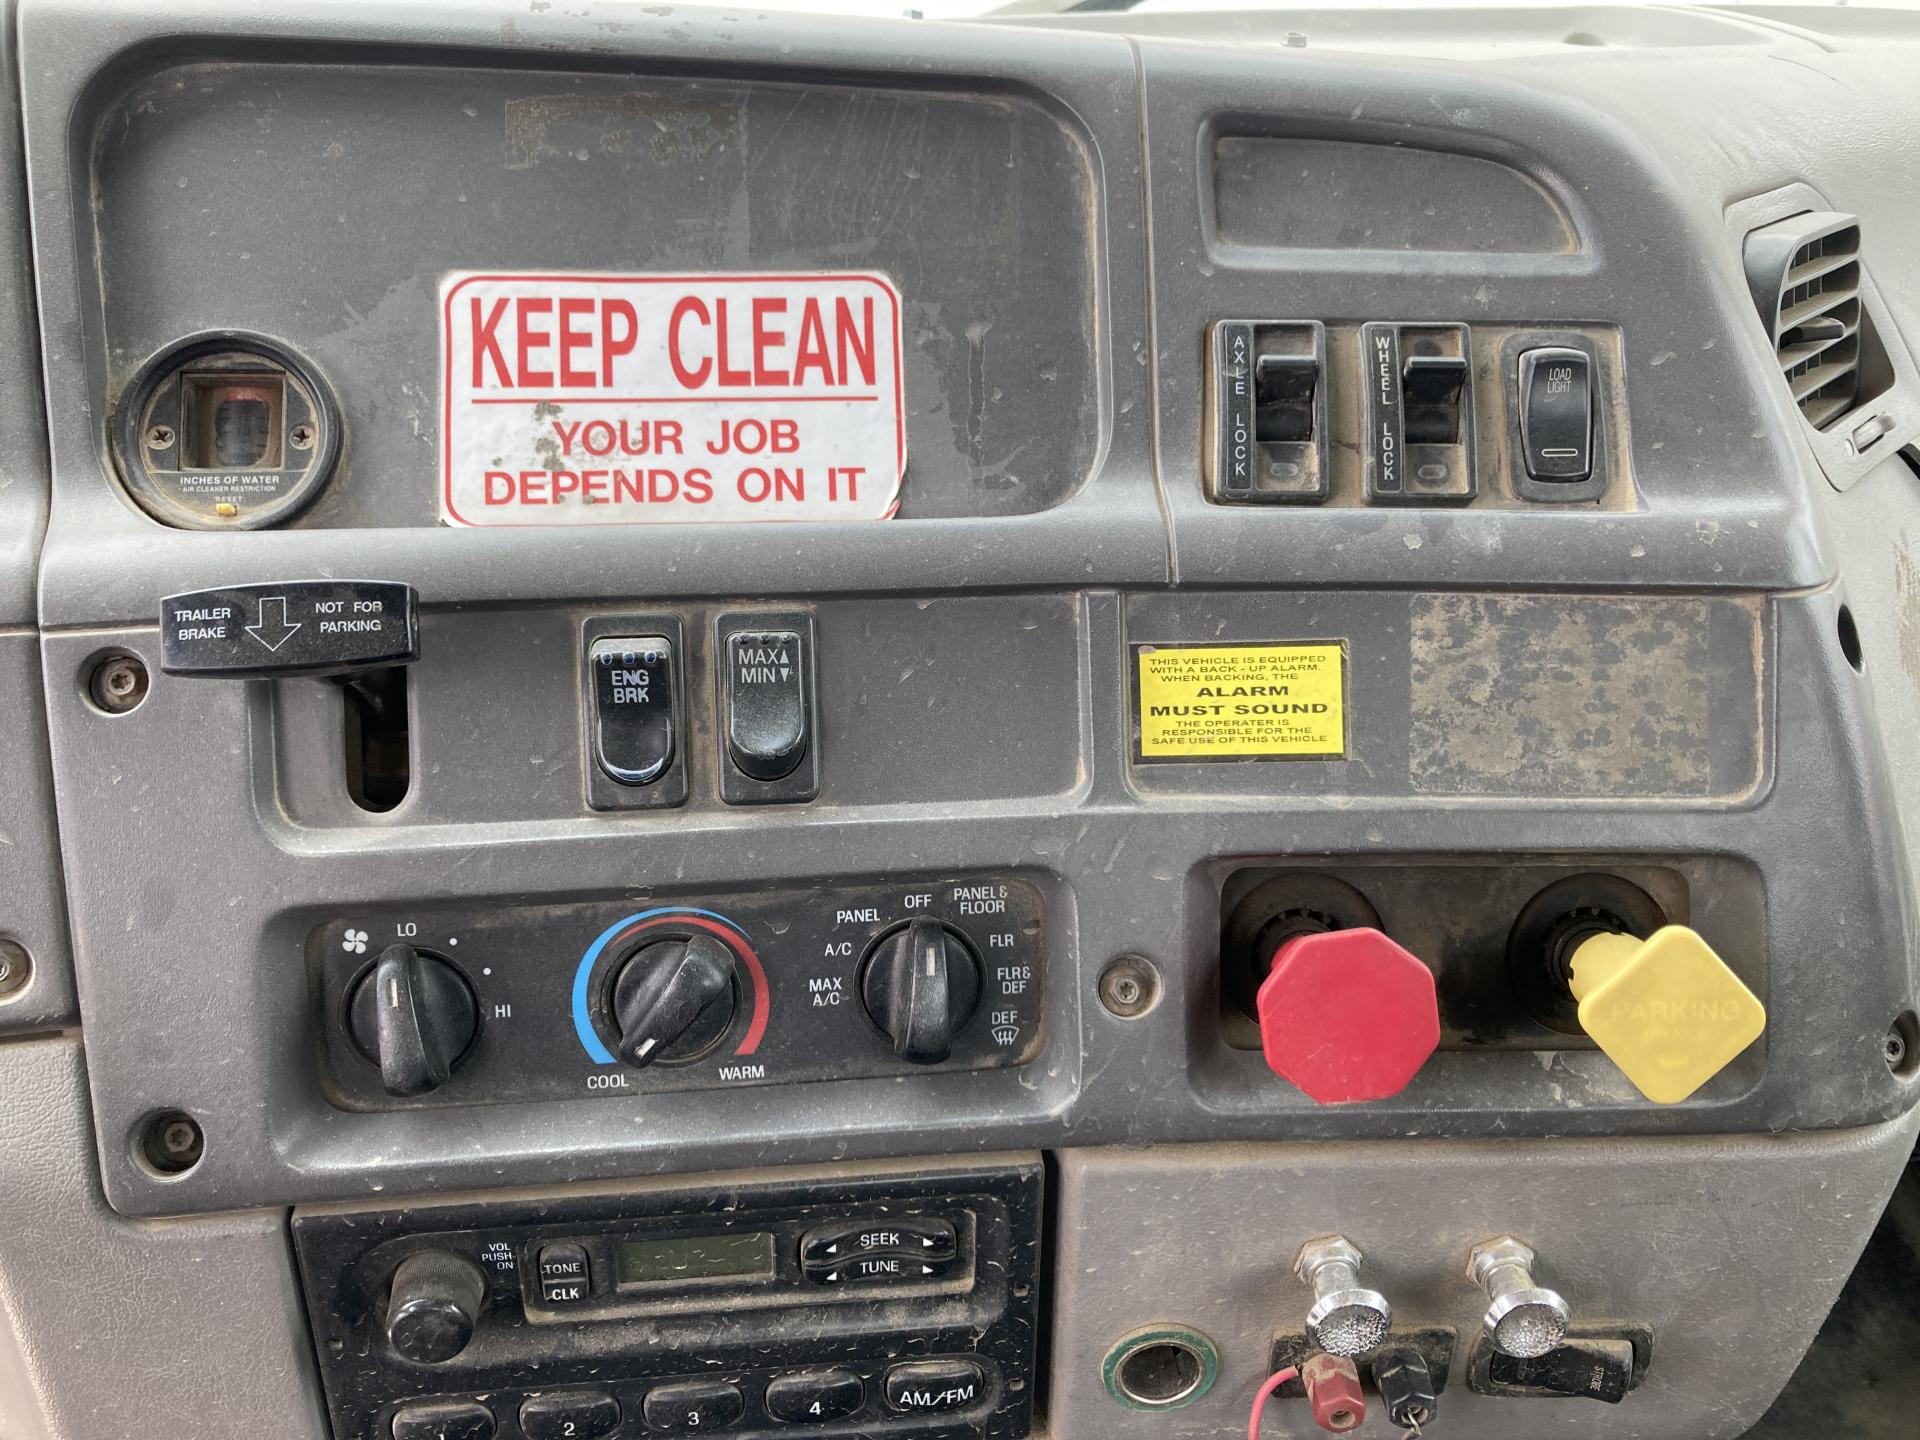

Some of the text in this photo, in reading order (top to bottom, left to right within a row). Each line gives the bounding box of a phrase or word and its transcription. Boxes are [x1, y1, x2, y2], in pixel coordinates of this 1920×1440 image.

[471, 296, 876, 390] KEEP CLEAN
[1549, 368, 1572, 381] LOAD
[1547, 381, 1572, 393] LIGHT
[1234, 336, 1247, 476] AXLE LOCK
[1376, 336, 1394, 481] WHEEL LOCK
[552, 418, 800, 456] YOUR JOB
[181, 475, 280, 485] INCHES OF WATER
[484, 467, 866, 506] DEPENDS ON IT
[316, 601, 383, 613] NOT FOR
[174, 608, 231, 622] TRAILER
[179, 627, 226, 641] BRAKE
[320, 620, 382, 634] PARKING
[739, 649, 779, 665] MAX
[1260, 656, 1326, 664] EQUIPPED
[612, 670, 649, 686] ENG
[742, 668, 775, 684] MIN
[614, 688, 649, 704] BRK
[1196, 686, 1289, 697] ALARM
[1150, 704, 1328, 717] MUST SOUND
[1162, 728, 1253, 736] RESPONSIBLE
[1152, 737, 1185, 745] SAFE
[954, 886, 996, 900] PANEL
[904, 894, 932, 909] OFF
[960, 900, 1005, 915] FLOOR
[836, 908, 880, 923] PANEL
[397, 923, 417, 937] LO
[990, 934, 1014, 947] FLR
[825, 943, 851, 956] A/C
[809, 977, 842, 992] MAX
[1002, 981, 1027, 994] DEF
[813, 992, 840, 1006] A/C
[495, 1004, 511, 1018] HI
[992, 1011, 1018, 1024] DEF
[719, 1065, 765, 1081] WARM
[587, 1074, 629, 1090] COOL
[860, 1233, 899, 1246] SEEK
[488, 1243, 511, 1251] VOL
[482, 1252, 512, 1261] PUSH
[497, 1262, 514, 1270] ON
[544, 1262, 580, 1274] TONE
[860, 1260, 899, 1274] TUNE
[552, 1288, 579, 1300] CLK
[900, 1385, 974, 1406] AM/FM
[810, 1402, 821, 1415] 4
[688, 1412, 699, 1425] 3
[564, 1422, 575, 1436] 2
